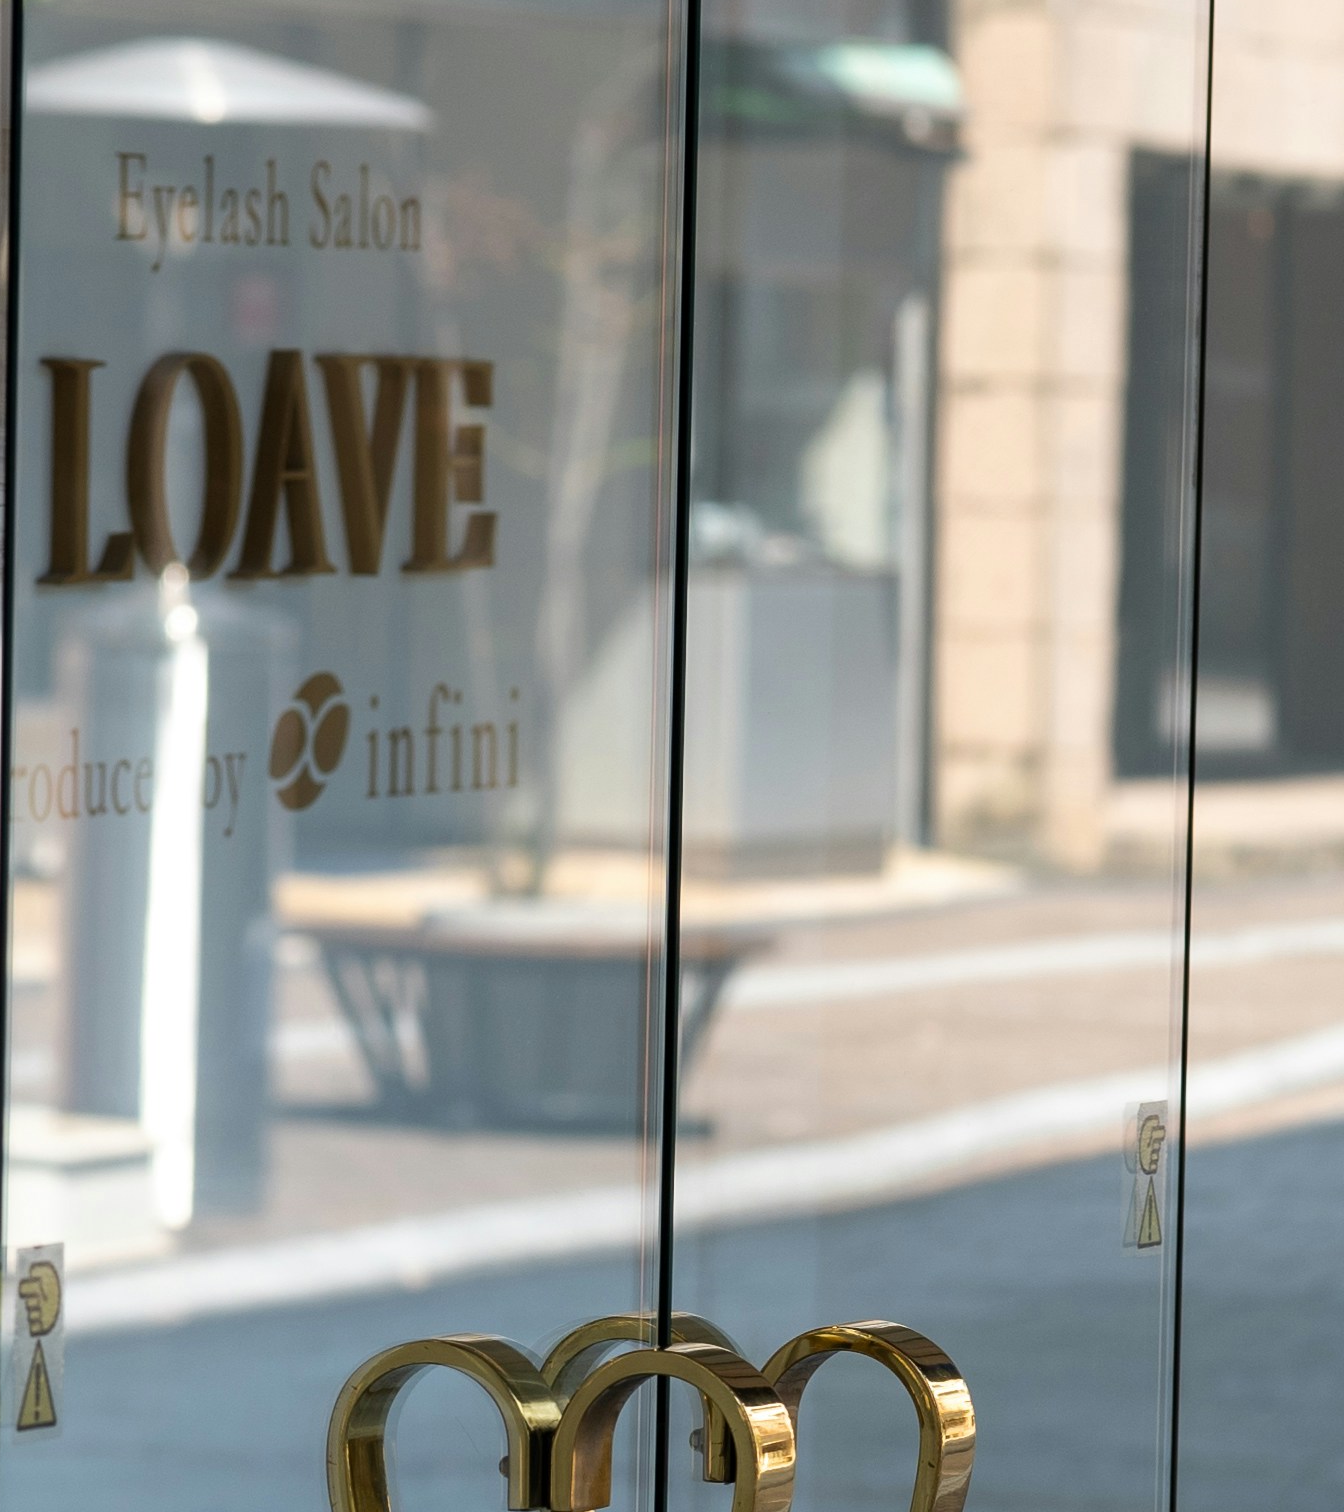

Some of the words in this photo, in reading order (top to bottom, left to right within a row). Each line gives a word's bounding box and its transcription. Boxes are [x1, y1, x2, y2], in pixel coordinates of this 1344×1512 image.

[114, 151, 291, 274] Eyelash
[308, 158, 424, 255] Salon
[35, 348, 498, 588] LOAVE
[365, 683, 522, 802] infini
